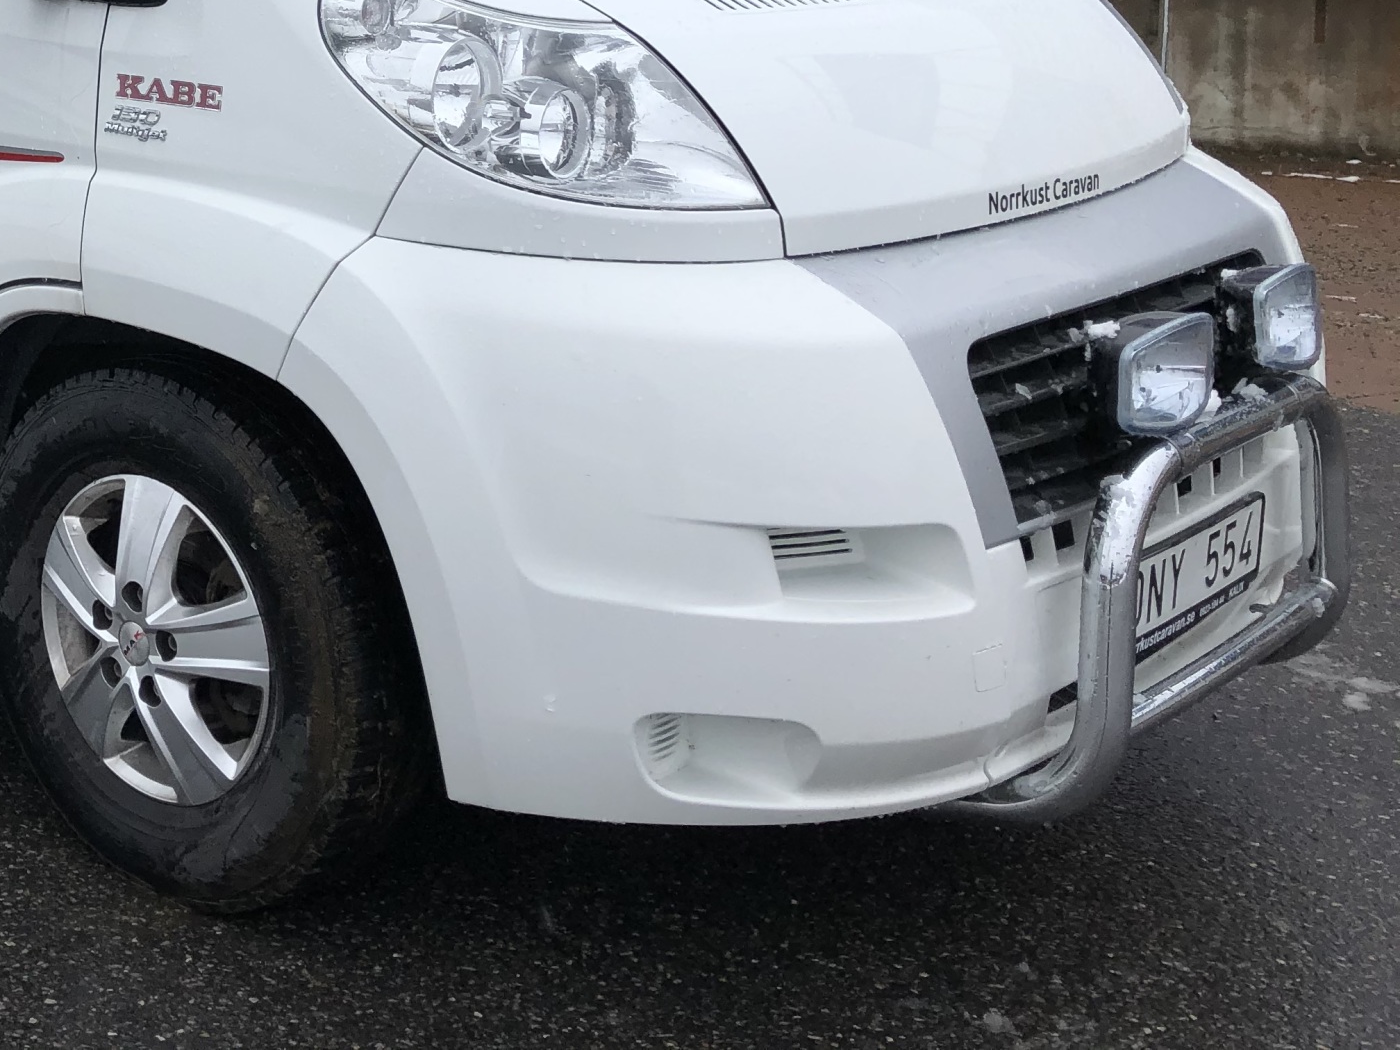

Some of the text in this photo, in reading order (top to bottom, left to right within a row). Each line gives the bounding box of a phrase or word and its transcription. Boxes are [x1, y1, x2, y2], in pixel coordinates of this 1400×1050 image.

[115, 73, 224, 112] KABE
[988, 173, 1100, 215] Norrkust Caravan
[1204, 509, 1254, 589] 554
